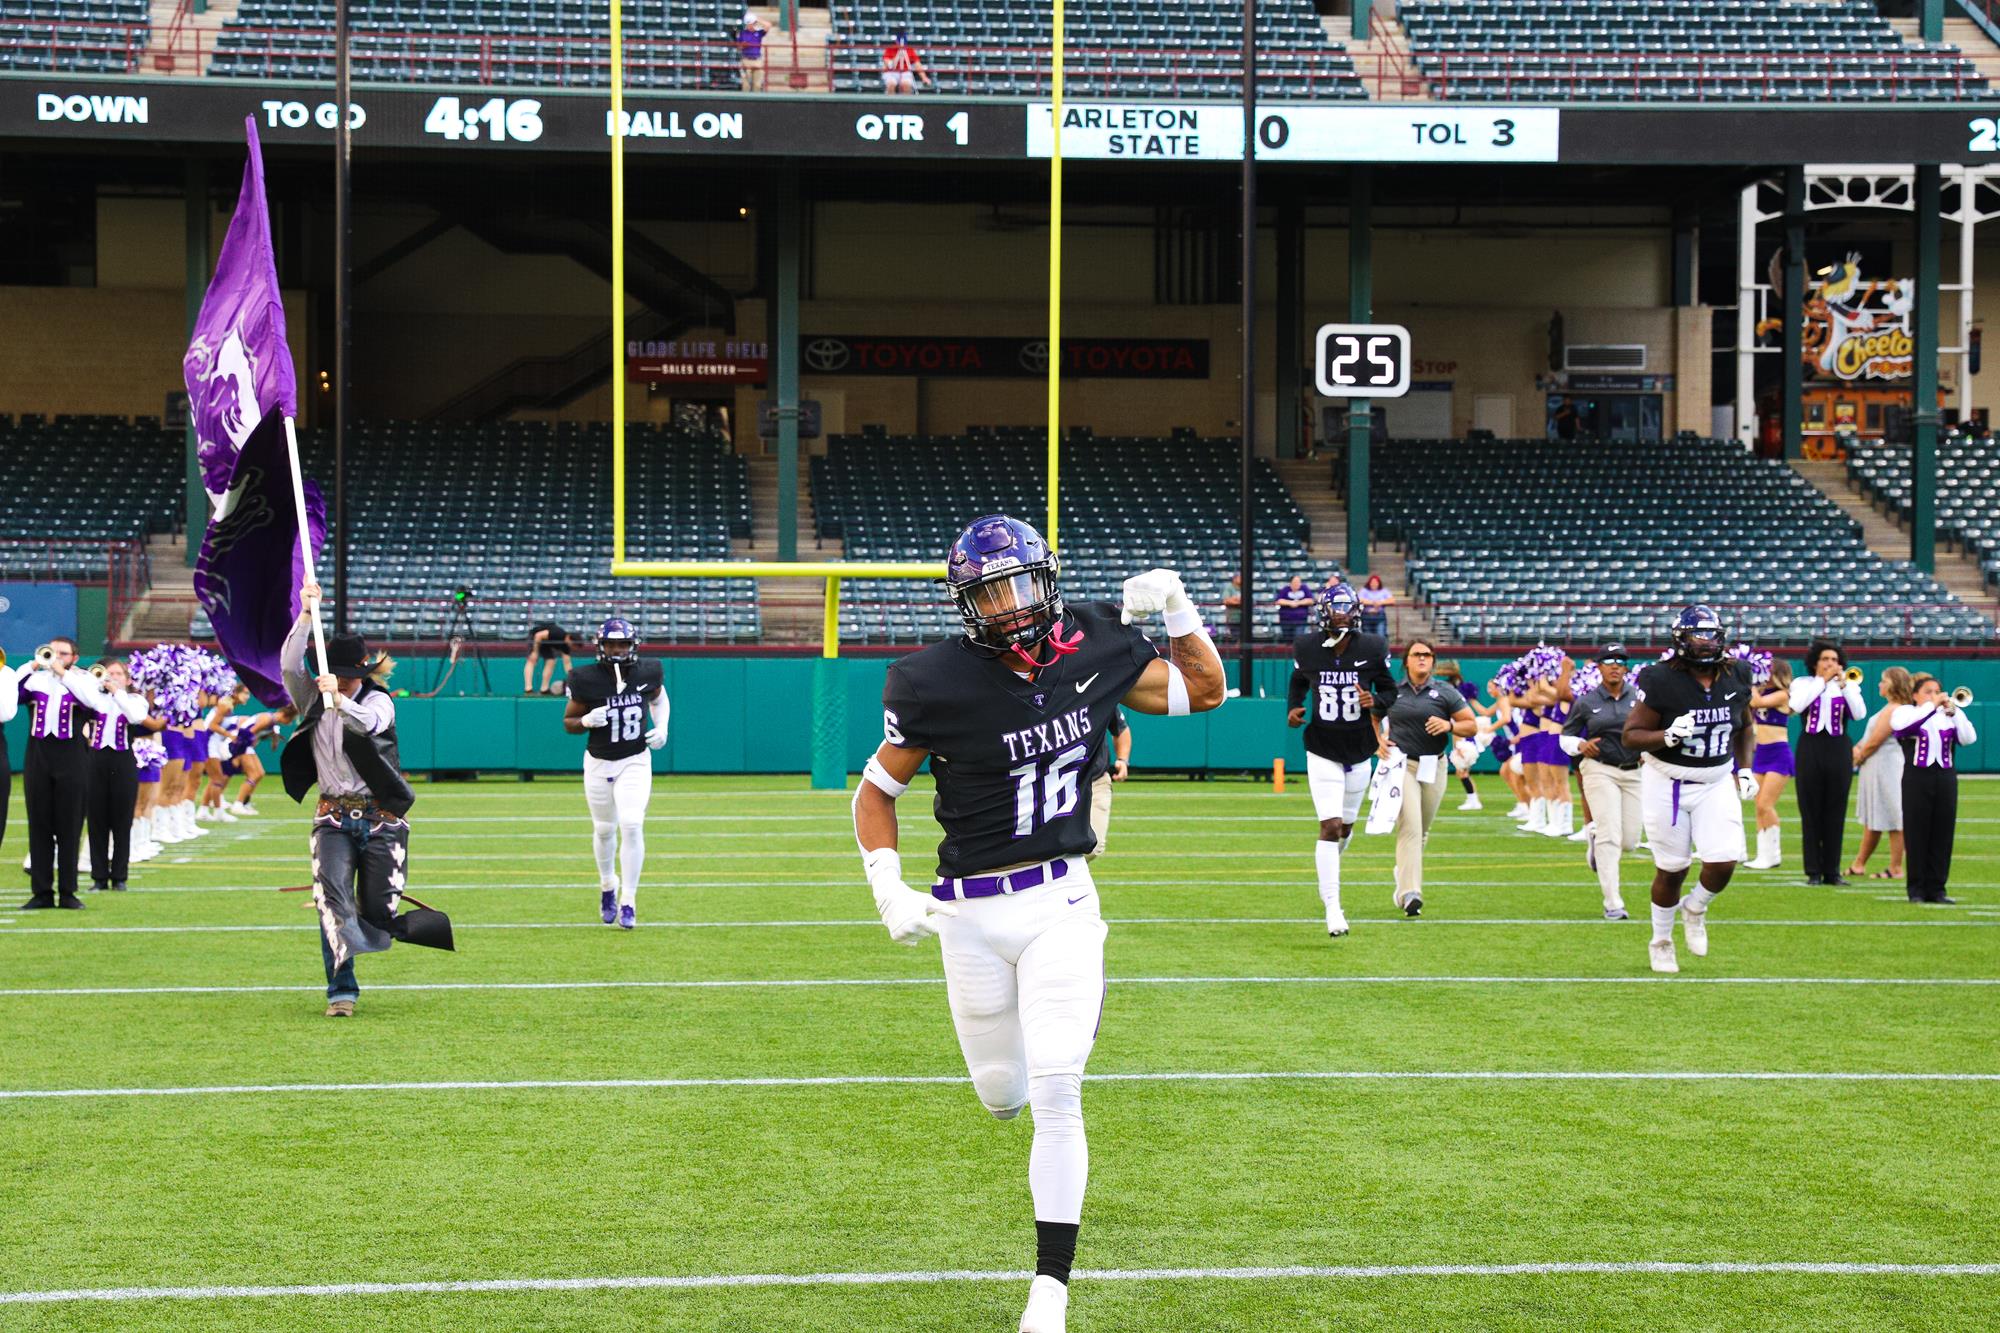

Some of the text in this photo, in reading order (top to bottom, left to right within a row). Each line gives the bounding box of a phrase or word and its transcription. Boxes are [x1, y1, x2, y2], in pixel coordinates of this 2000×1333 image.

[37, 94, 148, 123] DOWN
[262, 100, 367, 130] TO GO
[424, 97, 543, 141] 4:16
[606, 110, 743, 139] BALL ON
[856, 112, 969, 145] QTR 1
[1259, 115, 1289, 149] 0
[1412, 119, 1515, 147] TOL 3
[1968, 117, 2000, 152] 2
[1109, 134, 1199, 155] STATE
[628, 341, 768, 359] GLOBE LIFE FIELD
[853, 343, 983, 369] TOYOTA
[1068, 346, 1196, 371] TOYOTA
[1332, 337, 1394, 384] 25
[662, 364, 736, 376] SALES CENTER
[987, 559, 1014, 571] TEXANS
[1319, 671, 1359, 685] TEXANS
[606, 694, 642, 707] TEXANS
[1318, 685, 1361, 722] 88
[607, 705, 643, 743] 18
[1002, 706, 1092, 761] TEXANS
[1681, 722, 1733, 758] 50
[1008, 744, 1088, 838] 16
